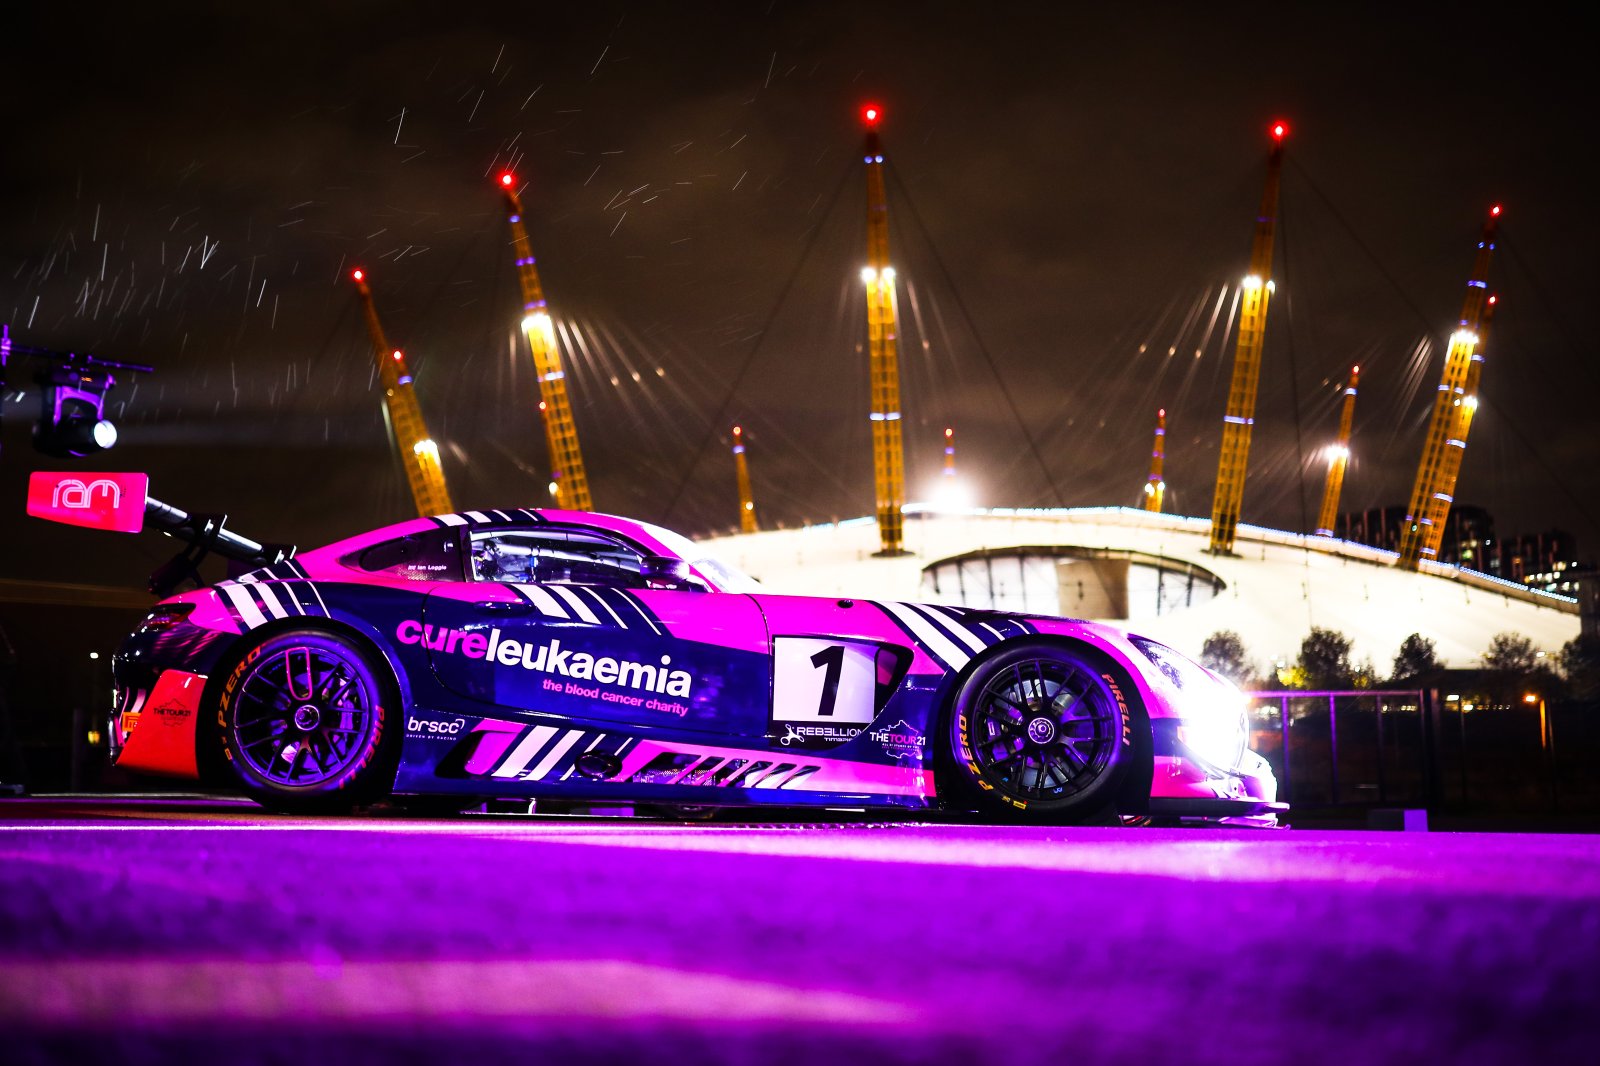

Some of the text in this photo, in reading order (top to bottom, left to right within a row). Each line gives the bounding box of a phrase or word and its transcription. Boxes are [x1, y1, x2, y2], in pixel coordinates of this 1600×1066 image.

[543, 679, 689, 717] the blood cancer charity
[810, 646, 845, 716] 1
[1101, 673, 1131, 746] PIRELLI
[338, 704, 385, 790] PIRELLI
[407, 716, 460, 734] brscc
